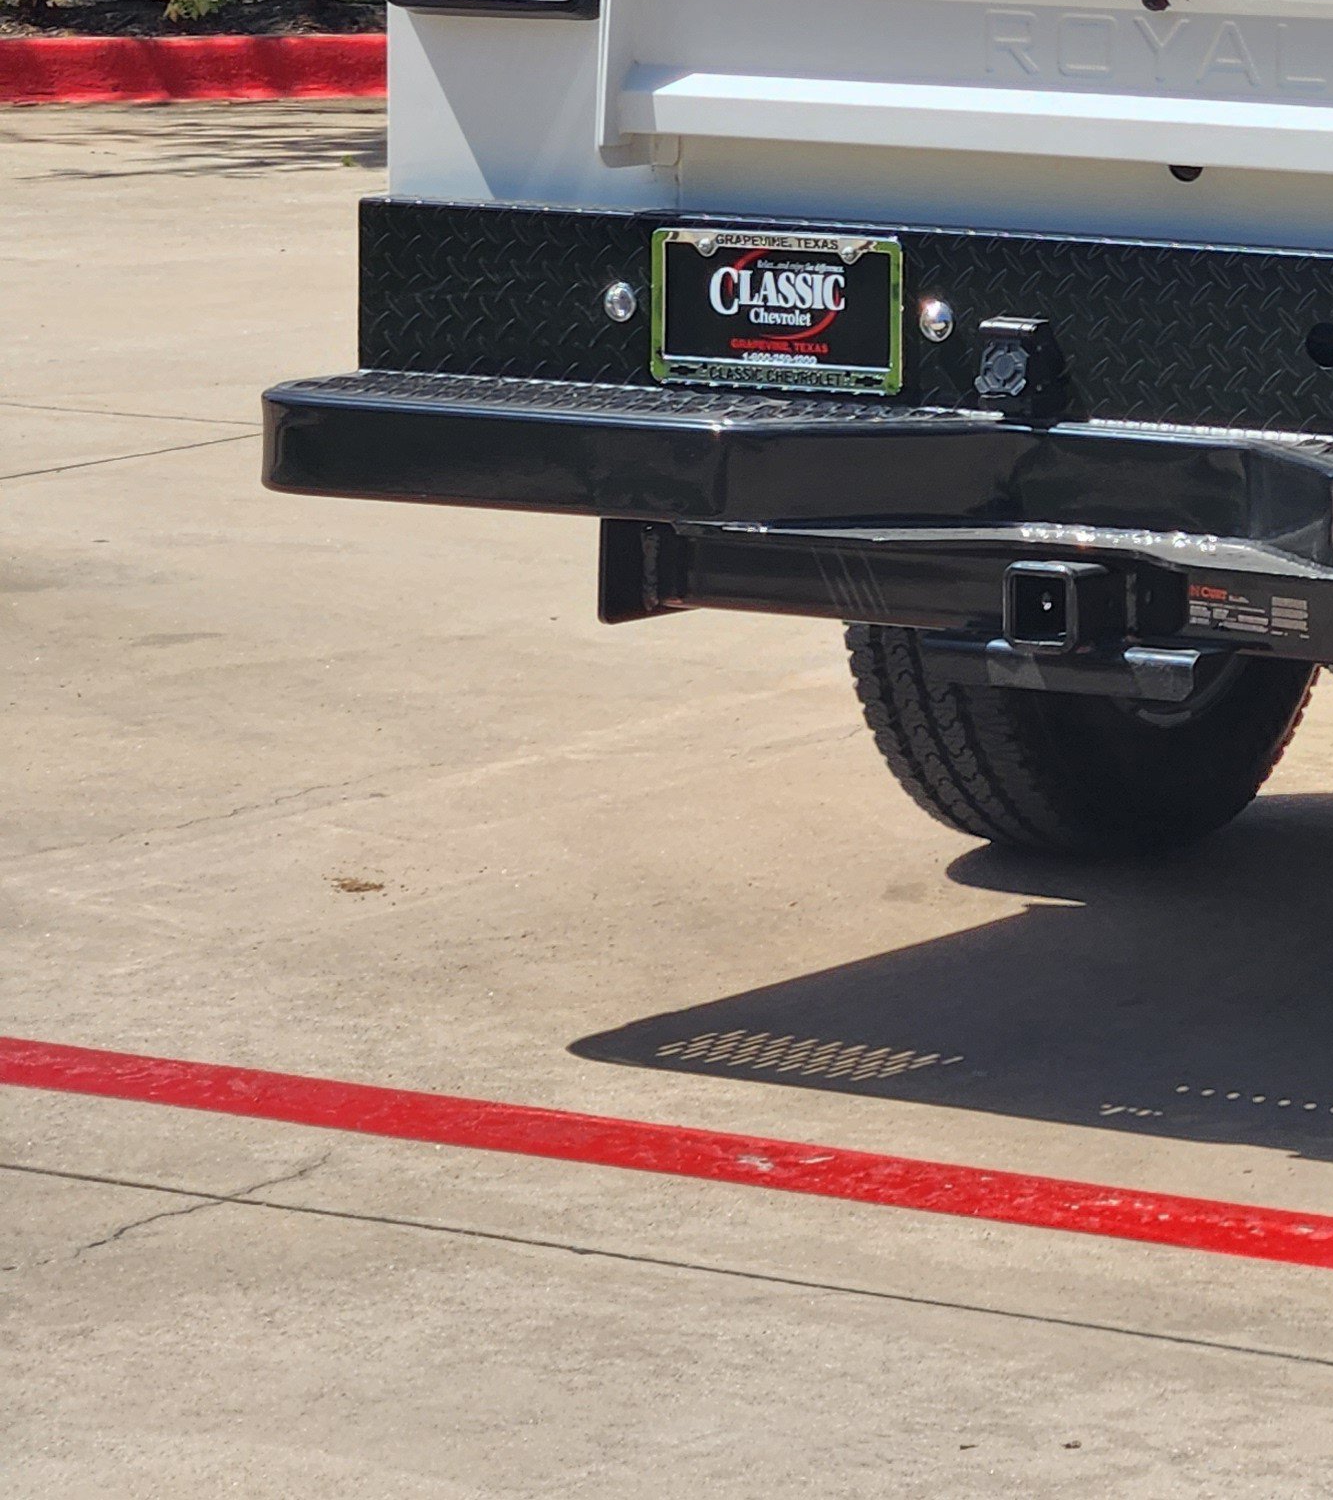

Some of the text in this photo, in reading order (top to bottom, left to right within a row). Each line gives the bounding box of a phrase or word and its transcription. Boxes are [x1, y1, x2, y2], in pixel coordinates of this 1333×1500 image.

[985, 8, 1327, 90] ROYAL
[797, 238, 839, 250] TEXAS
[709, 266, 845, 315] CLASSIC
[749, 307, 812, 327] Chevrolet
[710, 366, 841, 386] CLASSIC CHEVROLET
